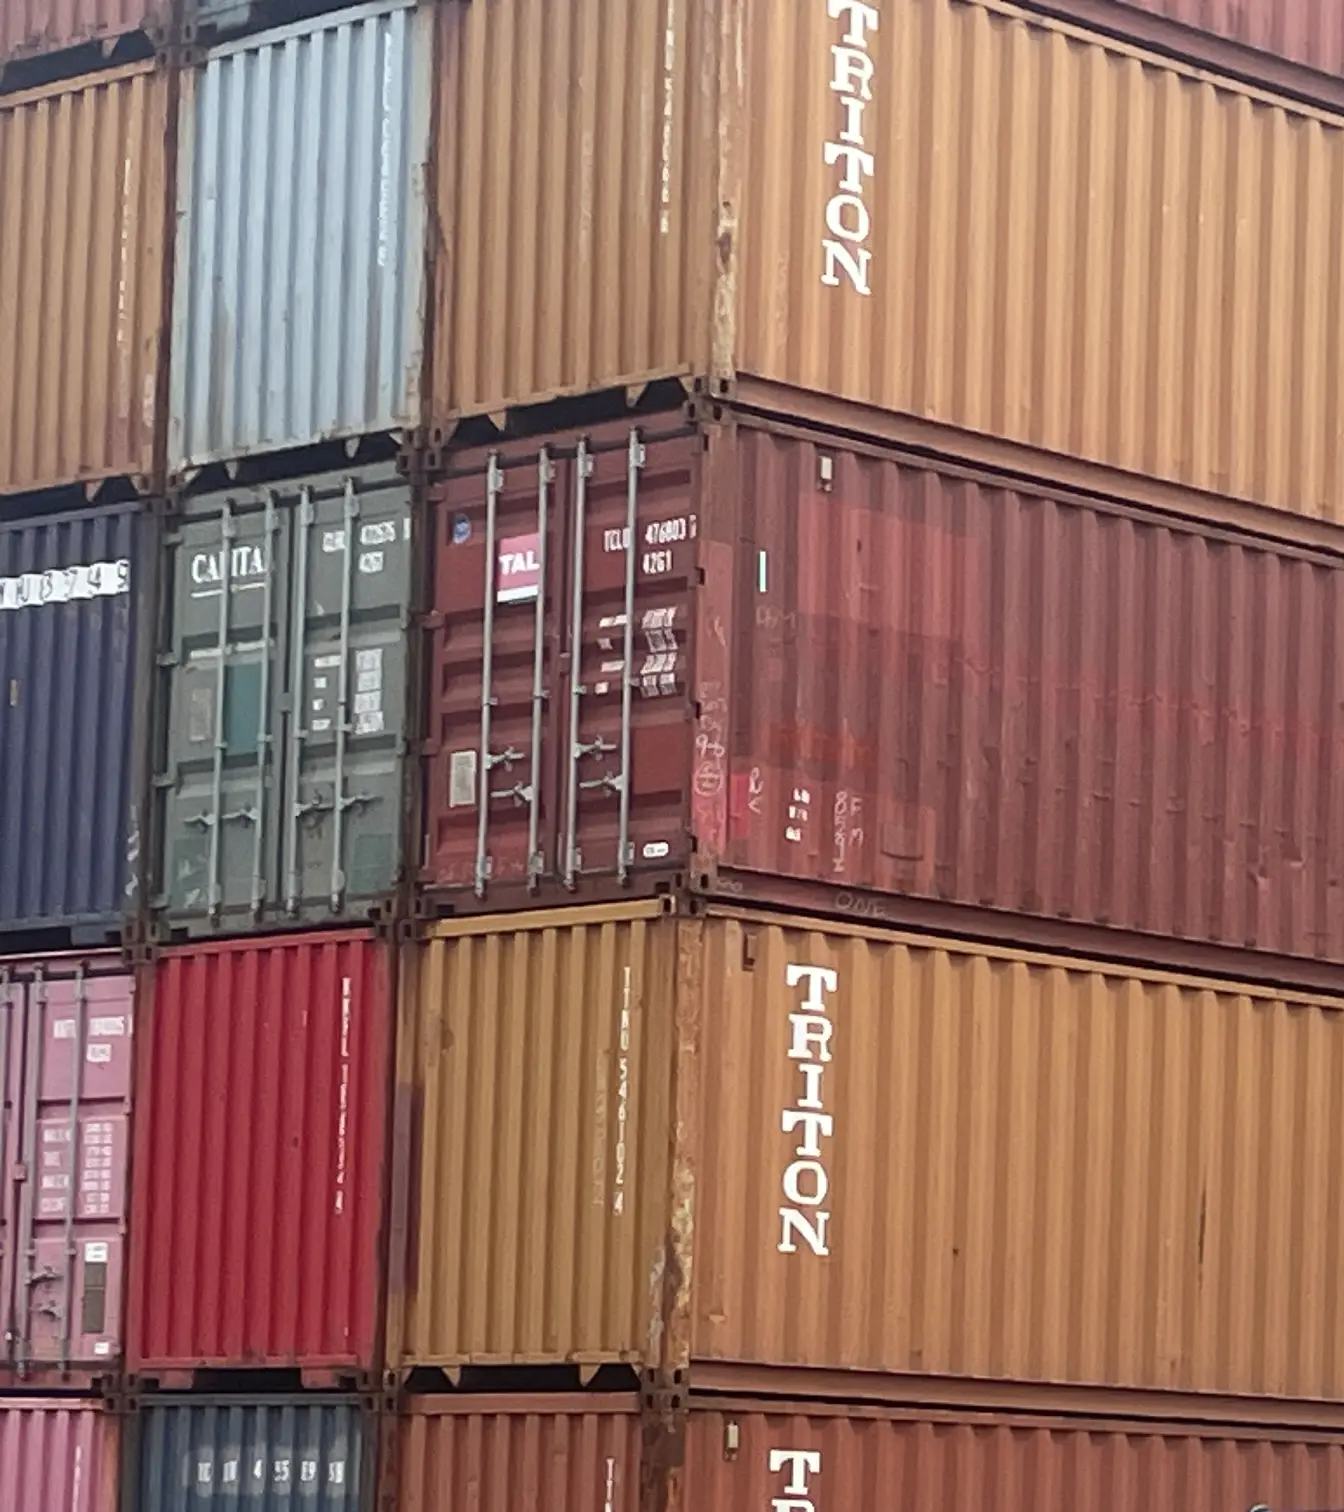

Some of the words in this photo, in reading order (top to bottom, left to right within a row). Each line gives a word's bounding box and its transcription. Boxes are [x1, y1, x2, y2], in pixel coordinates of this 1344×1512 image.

[821, 0, 879, 296] TRITON
[191, 546, 267, 584] CAITA
[499, 551, 540, 576] TAL
[777, 964, 837, 1256] TRITON
